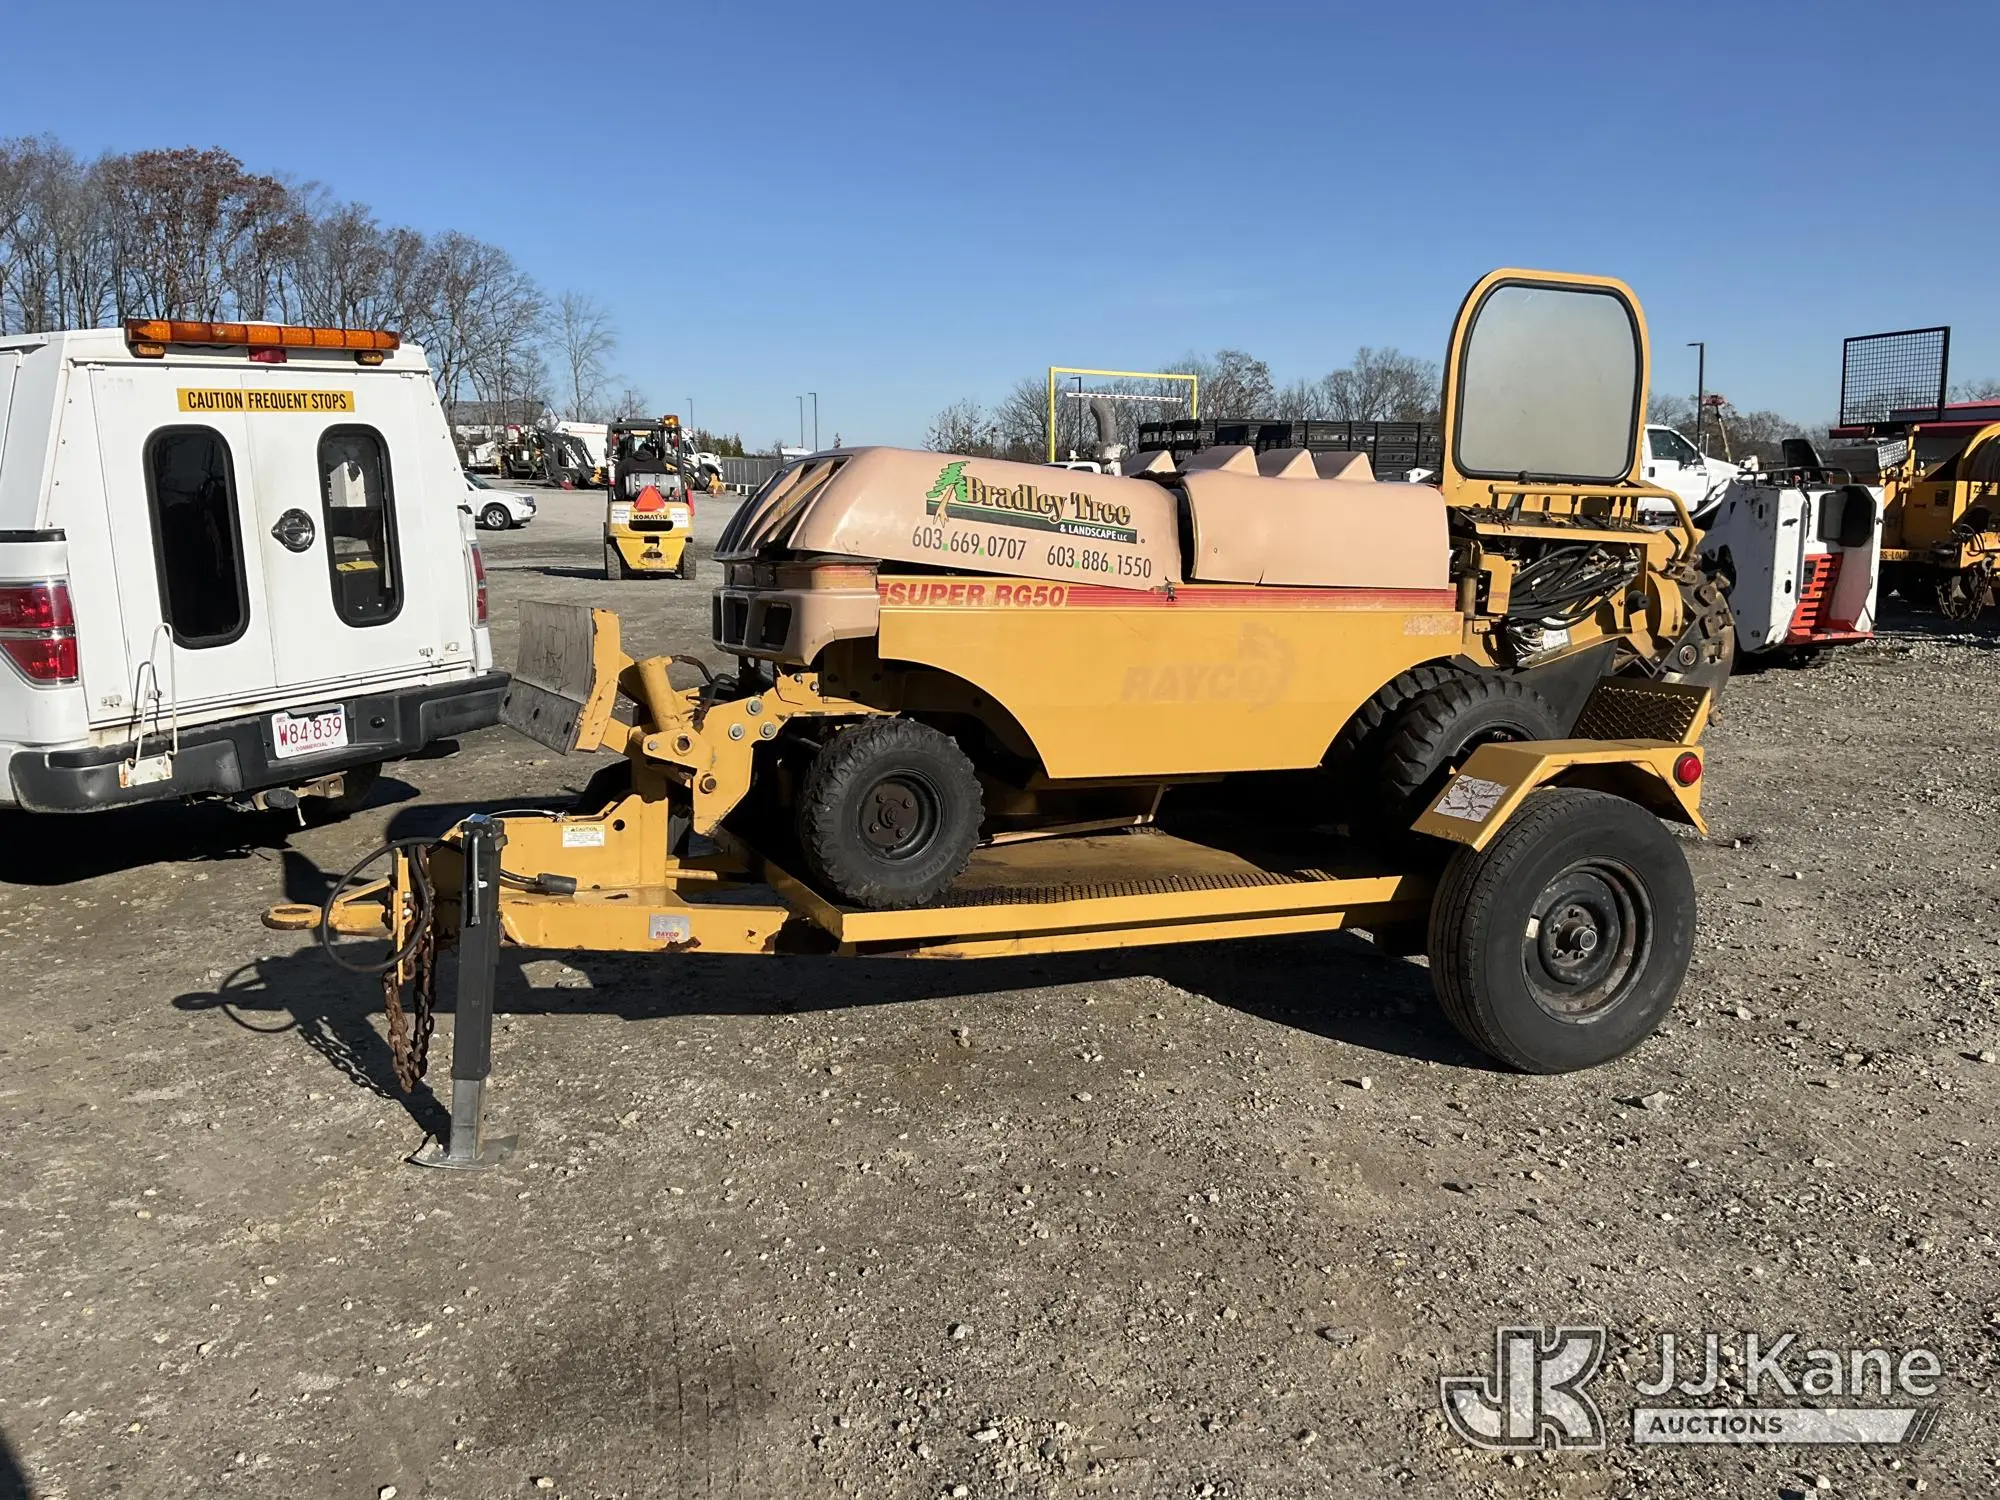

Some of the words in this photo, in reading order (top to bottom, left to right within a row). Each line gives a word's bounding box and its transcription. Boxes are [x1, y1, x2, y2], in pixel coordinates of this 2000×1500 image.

[188, 391, 243, 409] CAUTION
[248, 392, 308, 409] FREQUENT
[311, 393, 347, 409] STOPS
[964, 475, 1067, 523] Bradley
[1070, 491, 1131, 526] Tree
[1060, 523, 1067, 534] &
[1068, 525, 1117, 540] LANDSCAPE
[1117, 533, 1128, 541] LLC
[888, 582, 985, 606] SUPER
[993, 584, 1065, 608] RG50
[1122, 664, 1264, 700] RAYCO
